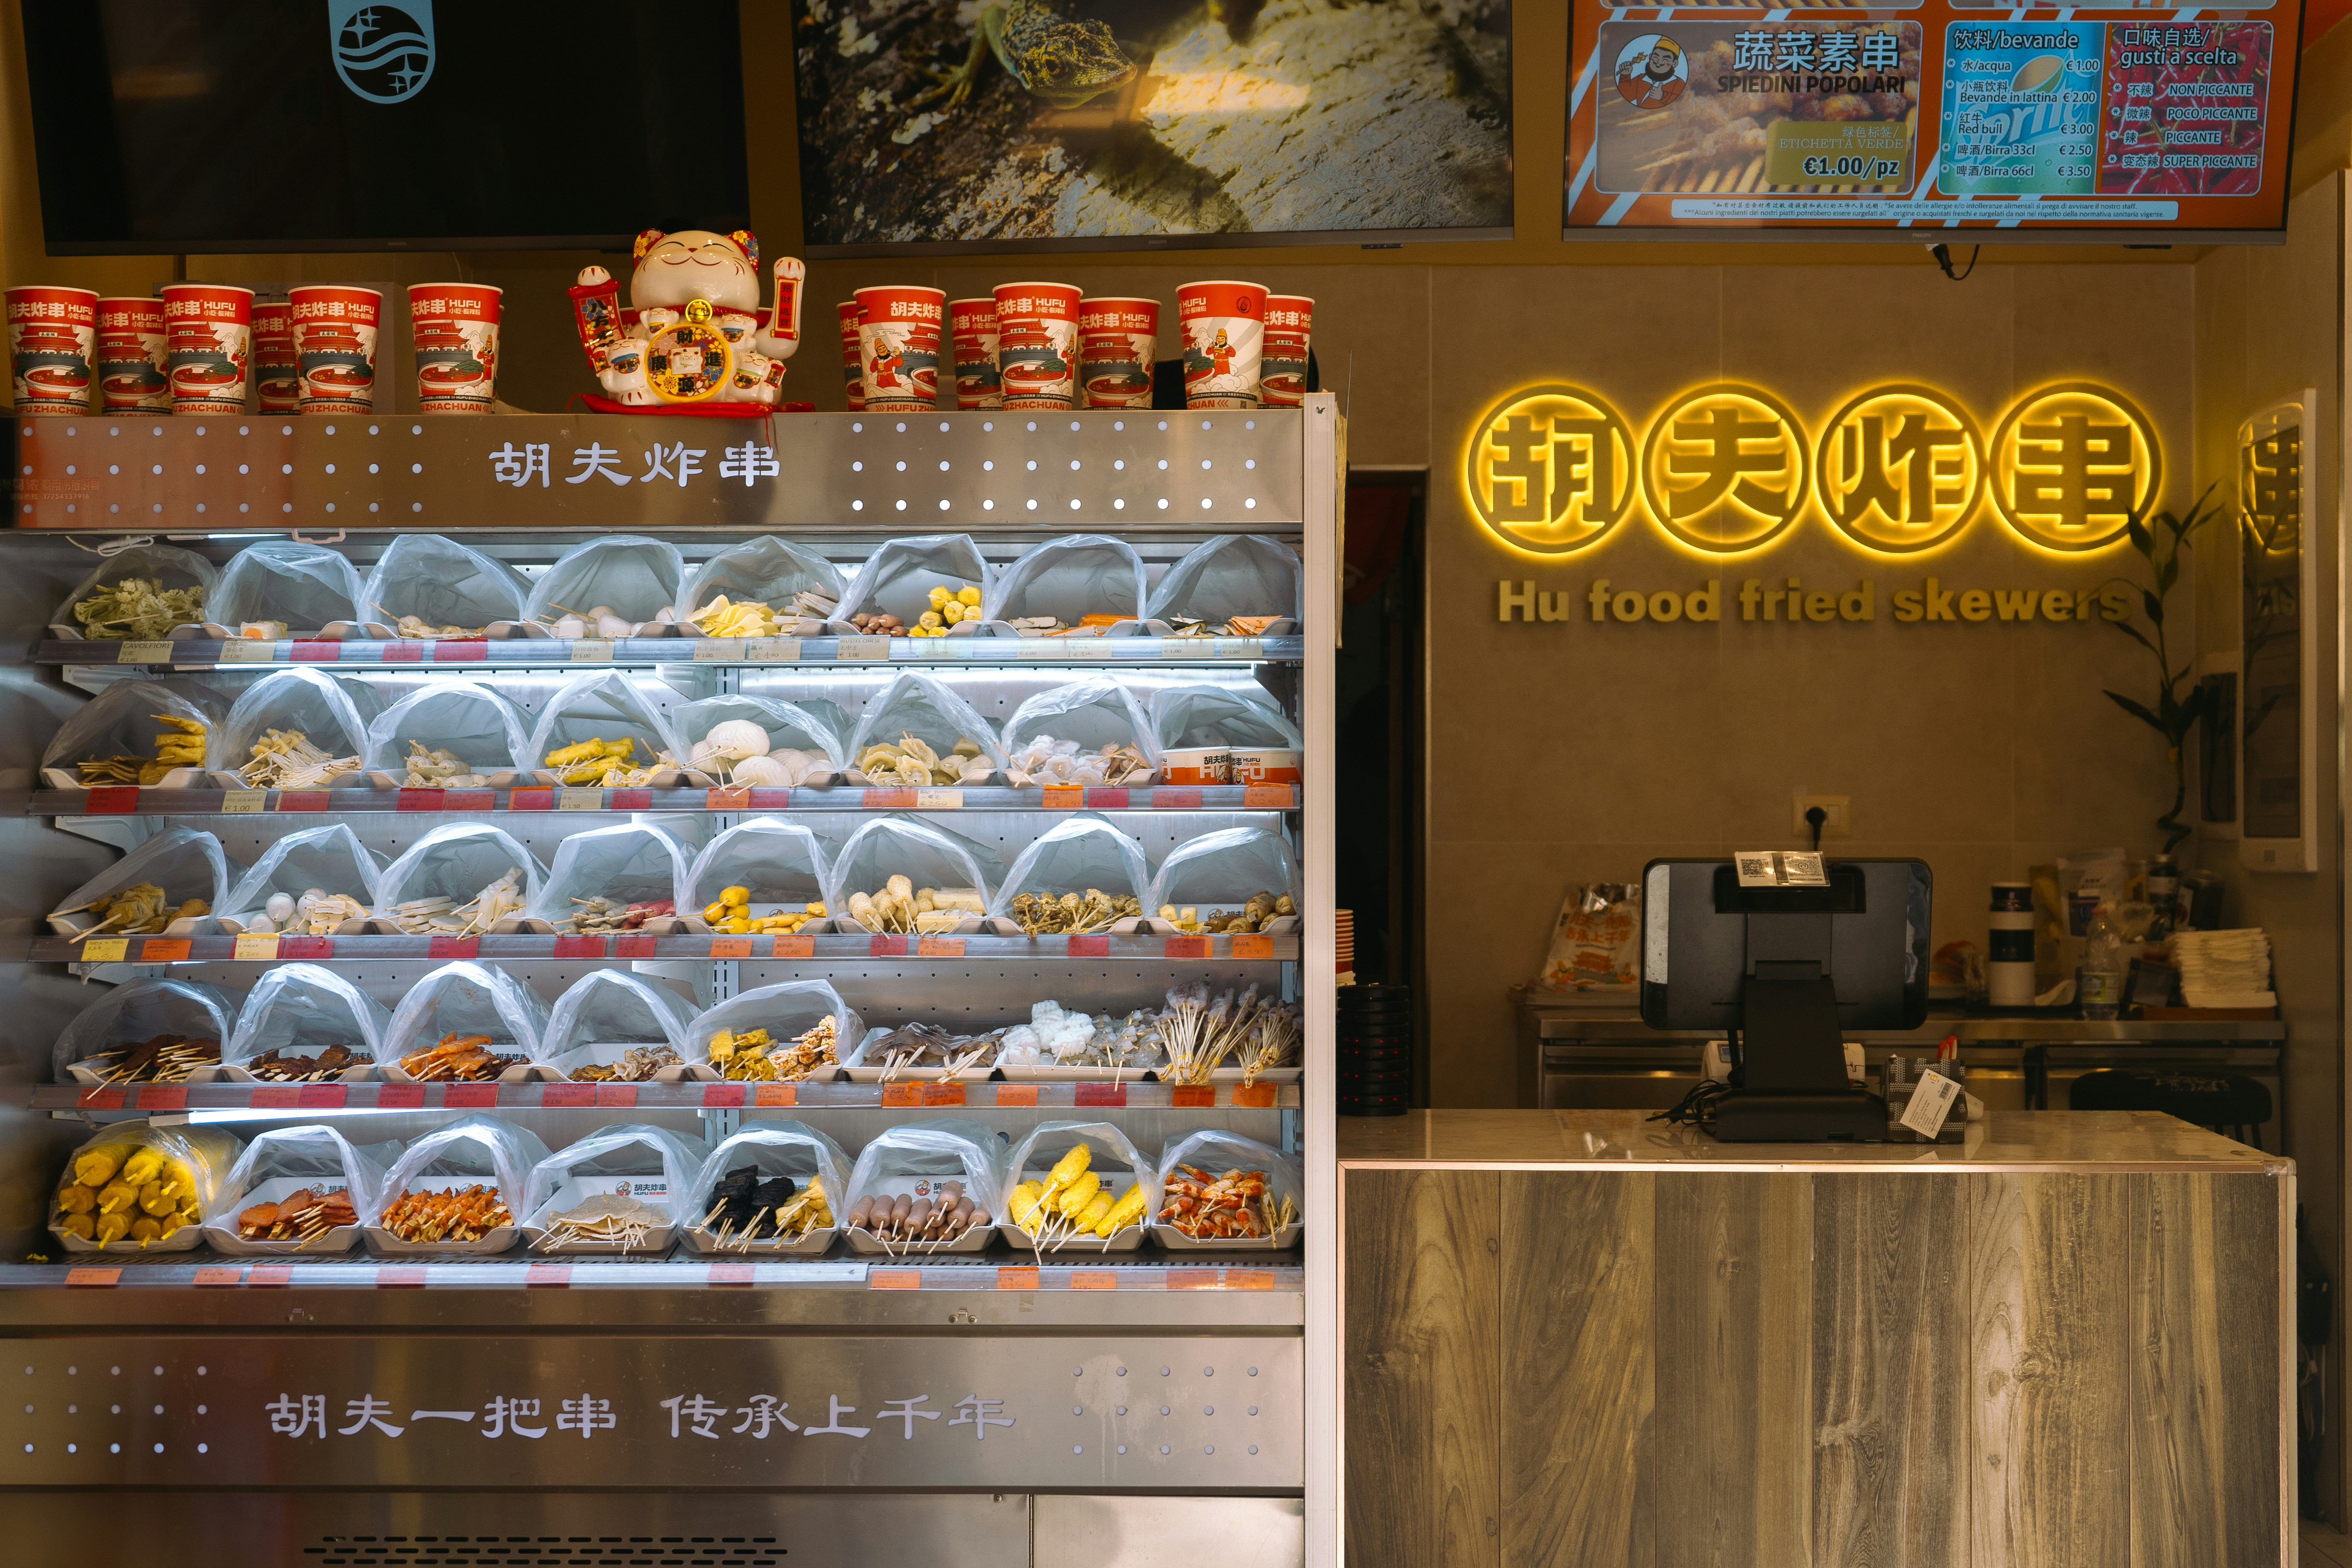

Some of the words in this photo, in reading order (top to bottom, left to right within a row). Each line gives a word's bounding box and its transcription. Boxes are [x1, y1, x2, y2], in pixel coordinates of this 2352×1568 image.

[1954, 29, 2079, 50] 饮料/bevande
[2124, 28, 2210, 47] 口味自选/
[1733, 31, 1898, 72] 蔬菜素串
[2121, 47, 2165, 68] gusti
[2170, 51, 2180, 65] a
[2185, 47, 2237, 65] scelta
[1962, 61, 2011, 72] 水/acqua
[2066, 61, 2073, 70] €
[2077, 61, 2099, 70] 1.00
[1718, 75, 1801, 93] SPIEDINI
[1807, 75, 1905, 93] POPOLARI
[1961, 81, 2008, 93] 小瓶饮料
[2128, 84, 2153, 96] 不辣
[2170, 84, 2197, 96] NON
[2198, 84, 2253, 96] PICCANTE
[1961, 92, 2007, 102] Bevande
[2010, 92, 2020, 102] in
[2023, 92, 2057, 102] lattina
[2063, 93, 2070, 102] €
[2072, 93, 2096, 102] 2.00
[1959, 113, 1982, 125] 红牛
[2167, 108, 2200, 119] POCO
[2201, 108, 2257, 119] PICCANTE
[1842, 126, 1900, 138] 绿色标签/
[1958, 124, 1979, 134] Red
[1982, 123, 2002, 134] bull
[2061, 124, 2068, 134] €
[2070, 124, 2093, 134] 3.00
[2125, 131, 2137, 143] 辣
[2165, 132, 2221, 143] PICCANTE
[1780, 138, 1853, 149] ETICHETTA
[1858, 138, 1904, 149] VERDE
[1958, 145, 2010, 155] 啤酒/Birra
[2013, 145, 2035, 155] 33cl
[2059, 145, 2066, 155] €
[2068, 145, 2092, 155] 2.50
[2123, 156, 2159, 168] 变态辣
[2164, 156, 2199, 167] SUPER
[2201, 156, 2257, 167] PICCANTE
[1804, 156, 1899, 180] €1.00/pz
[1956, 165, 2009, 176] 啤酒/Birra
[2012, 165, 2034, 176] 66cl
[2058, 166, 2065, 176] €
[2067, 166, 2091, 176] 3.50
[203, 301, 236, 311] HUFU
[348, 302, 374, 313] HUFU
[449, 299, 481, 309] HUFU
[1036, 298, 1066, 307] HUFU
[1182, 297, 1206, 307] HUFU
[68, 304, 93, 315] HUFU
[132, 313, 164, 322] HUFU
[1122, 313, 1150, 322] HUFU
[489, 441, 780, 488] 胡夫炸串
[1488, 405, 2138, 531] 胡夫炸串
[1499, 580, 1570, 622] Hu
[1589, 579, 1721, 622] food
[1740, 578, 1875, 622] fried
[1893, 577, 2130, 622] skewers
[265, 1393, 617, 1439] 胡夫一把串
[660, 1393, 1017, 1440] 传承上千年
